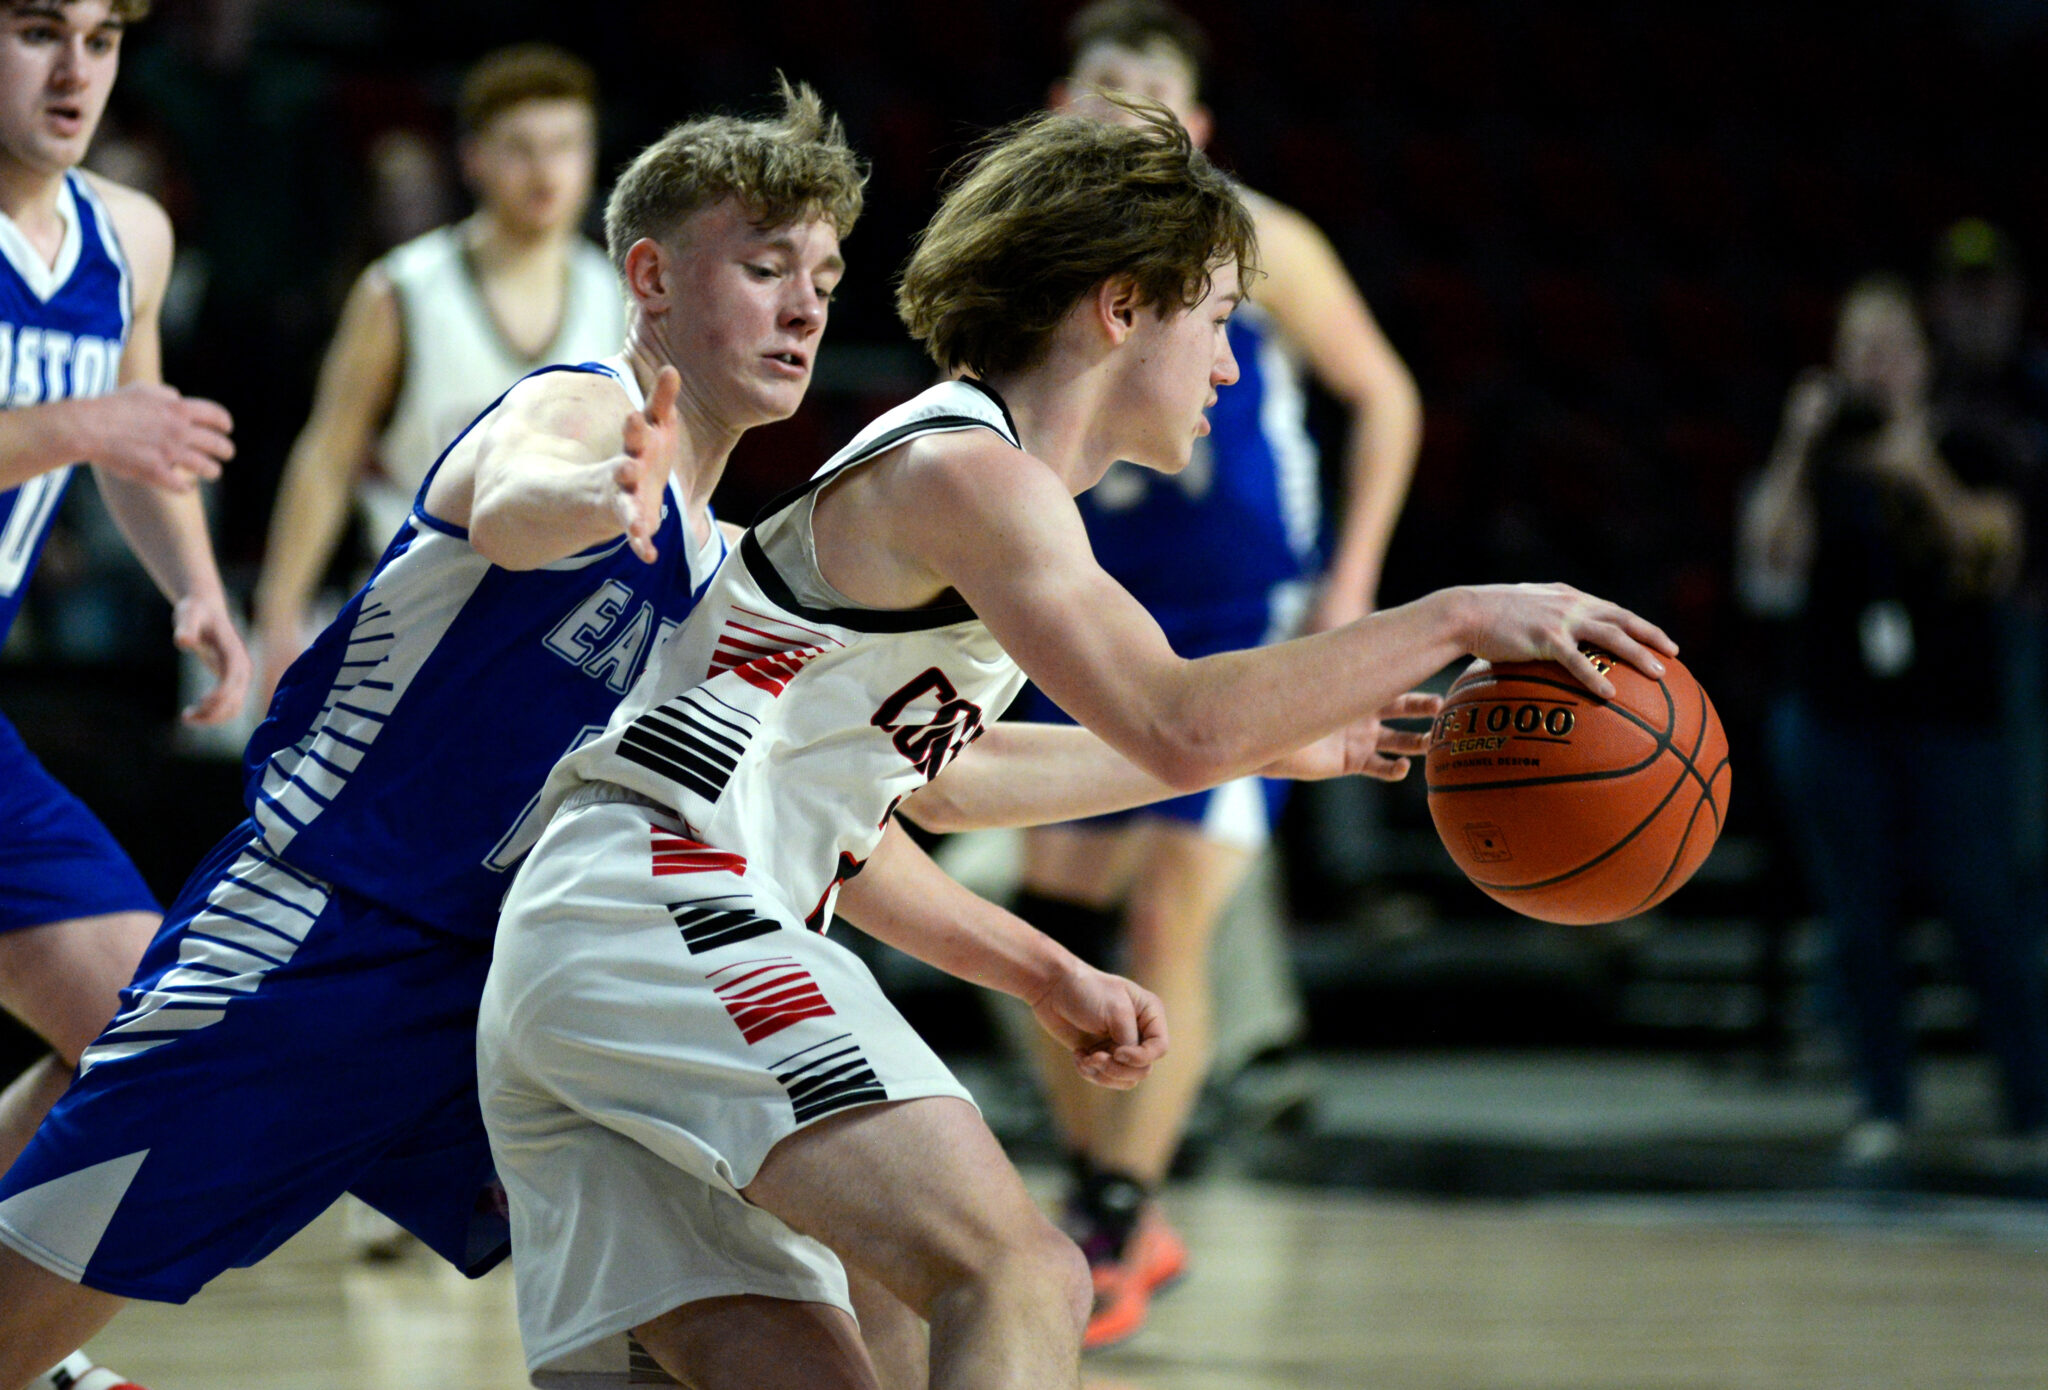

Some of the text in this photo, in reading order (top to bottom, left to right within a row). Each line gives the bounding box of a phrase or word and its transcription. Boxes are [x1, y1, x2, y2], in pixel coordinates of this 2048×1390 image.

[542, 578, 681, 695] EA
[869, 666, 985, 782] CO
[1450, 735, 1509, 755] LEGACY
[1497, 757, 1540, 767] DESIGN
